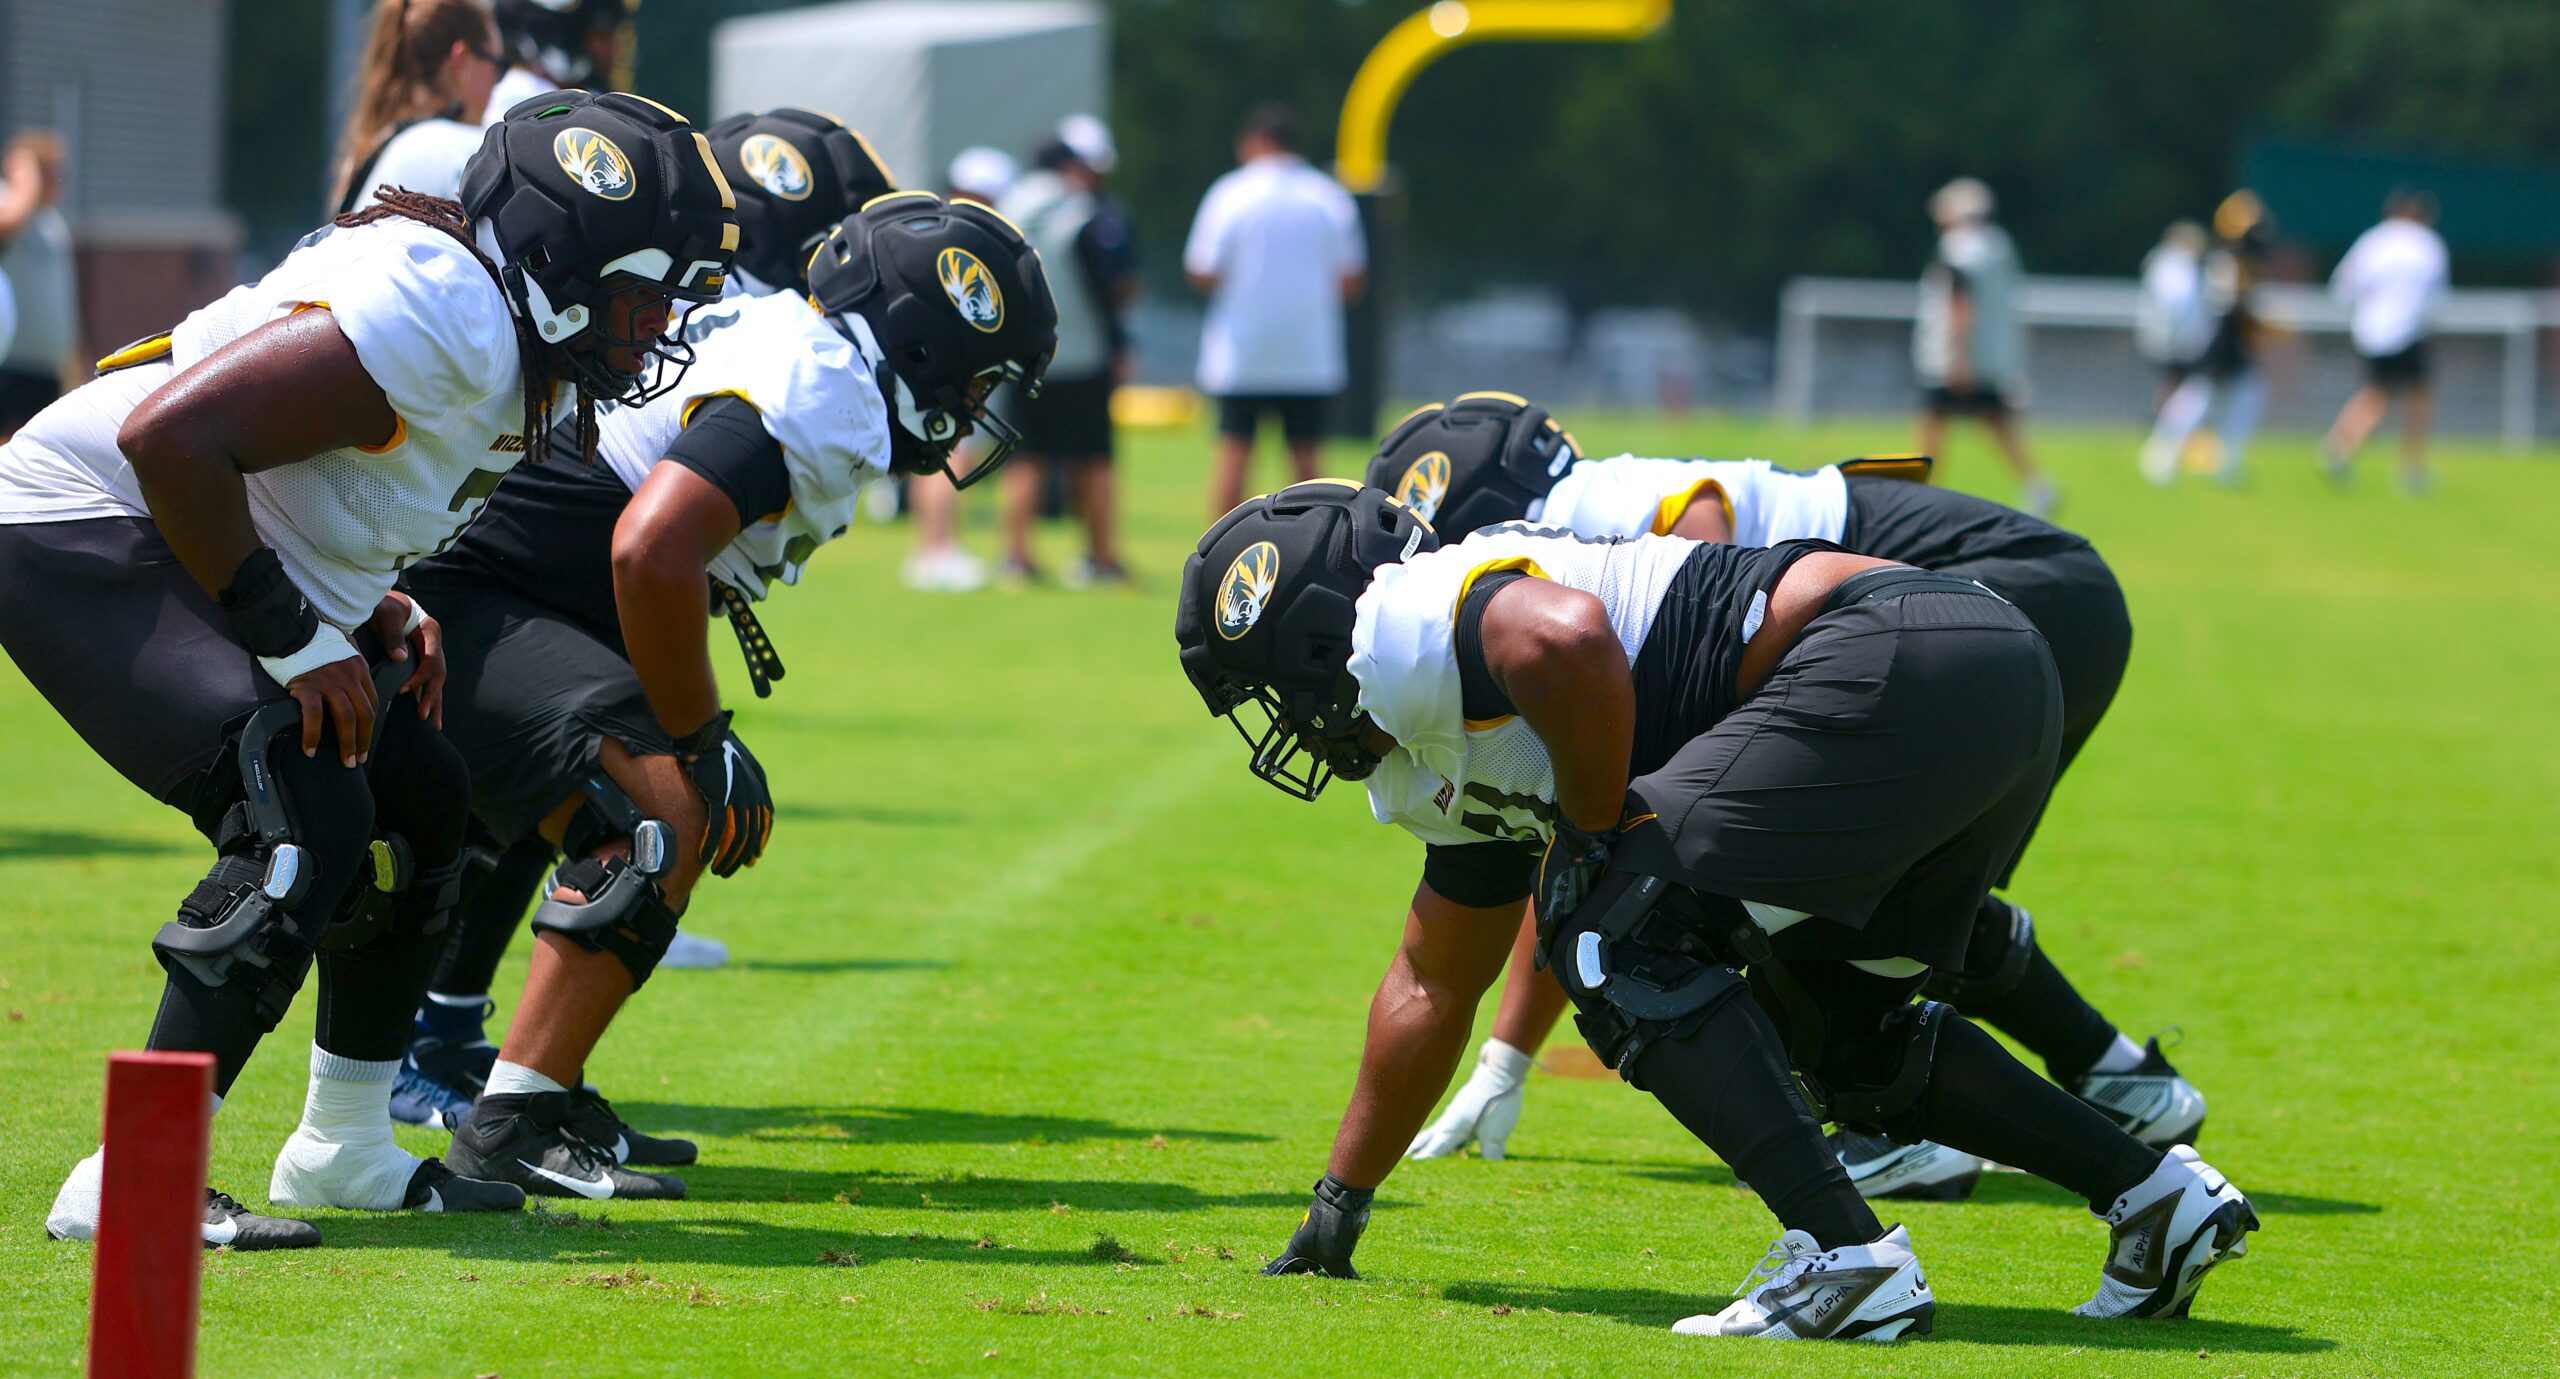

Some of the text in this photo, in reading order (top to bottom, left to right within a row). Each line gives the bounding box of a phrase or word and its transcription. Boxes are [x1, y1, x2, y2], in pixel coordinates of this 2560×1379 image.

[1884, 1153, 1937, 1180] FORCE
[2132, 1223, 2154, 1270] ALPHA
[1814, 1285, 1854, 1324] ALPHA
